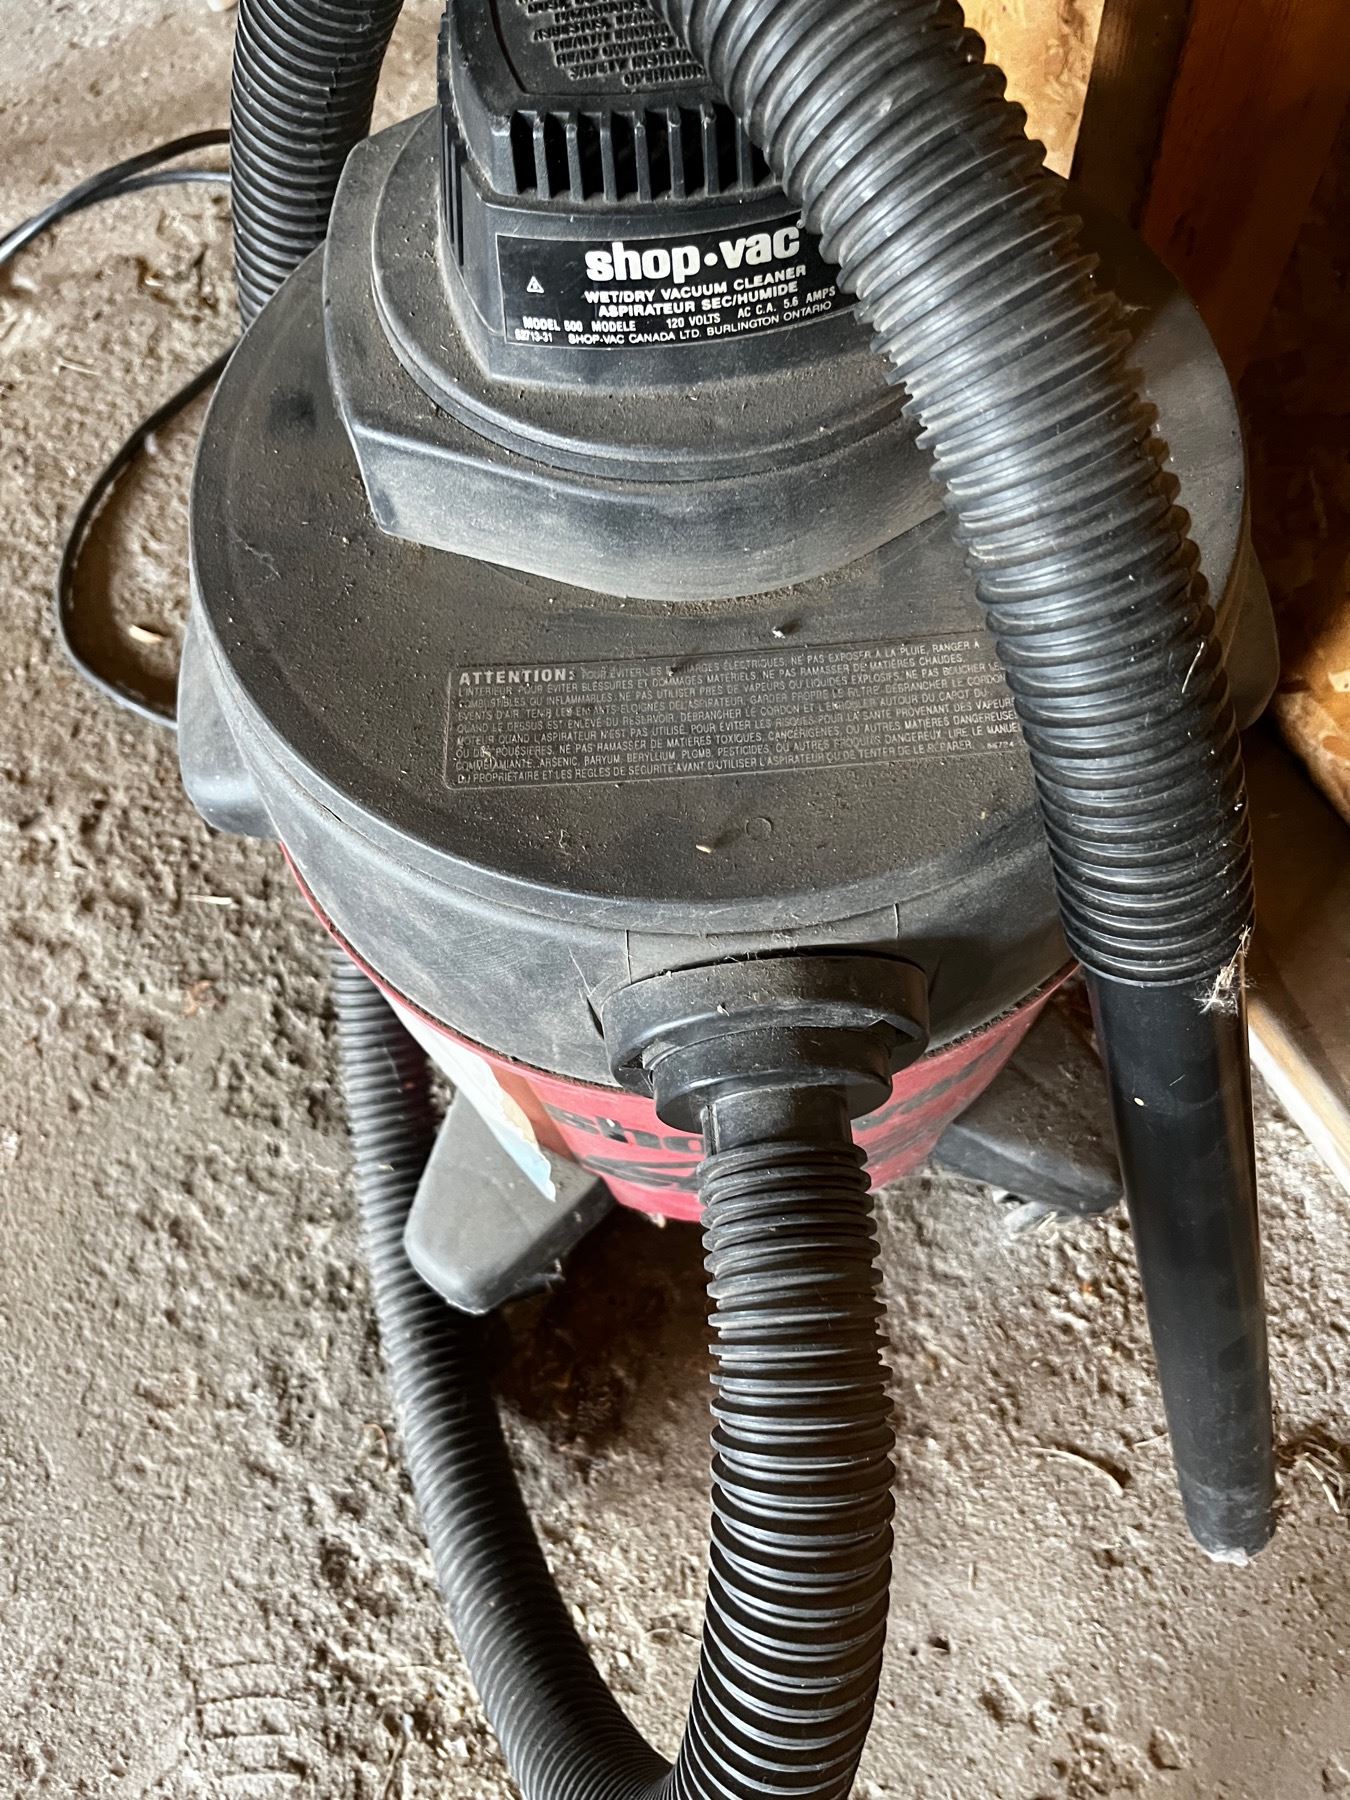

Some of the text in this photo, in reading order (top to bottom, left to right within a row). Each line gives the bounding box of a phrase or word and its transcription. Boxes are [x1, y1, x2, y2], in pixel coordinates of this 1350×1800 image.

[583, 265, 807, 303] WET/DRY VACUUM CLEANER
[598, 280, 798, 317] ASPIRATEUR SEC/HUMIDE
[522, 316, 561, 331] MODEL
[591, 320, 636, 332] MODELE
[666, 317, 684, 329] 120
[689, 313, 721, 327] VOLTS
[738, 308, 751, 318] AC
[755, 304, 777, 315] C.A.
[783, 297, 799, 309] 5.6
[806, 286, 836, 304] AMPS
[628, 331, 676, 343] CANADA
[679, 329, 702, 339] LTD.
[707, 315, 780, 337] BURLINGTON
[783, 301, 832, 321] ONTARIO
[458, 668, 574, 685] ATTENTION:
[806, 653, 824, 664] PAS
[932, 640, 970, 653] RANGER
[778, 667, 797, 678] PAS
[635, 689, 652, 700] PAS
[788, 679, 802, 689] OU
[921, 666, 938, 678] PAS
[921, 692, 934, 703] DU
[574, 742, 592, 753] PAS
[845, 724, 860, 735] OU
[864, 720, 900, 733] AUTRES
[630, 726, 648, 737] PAS
[690, 722, 716, 733] POUR
[774, 742, 790, 753] OU
[792, 739, 830, 752] AUTRES
[555, 768, 570, 779] LES
[675, 760, 704, 772] AVANT
[843, 749, 856, 760] DE
[896, 744, 910, 755] DE
